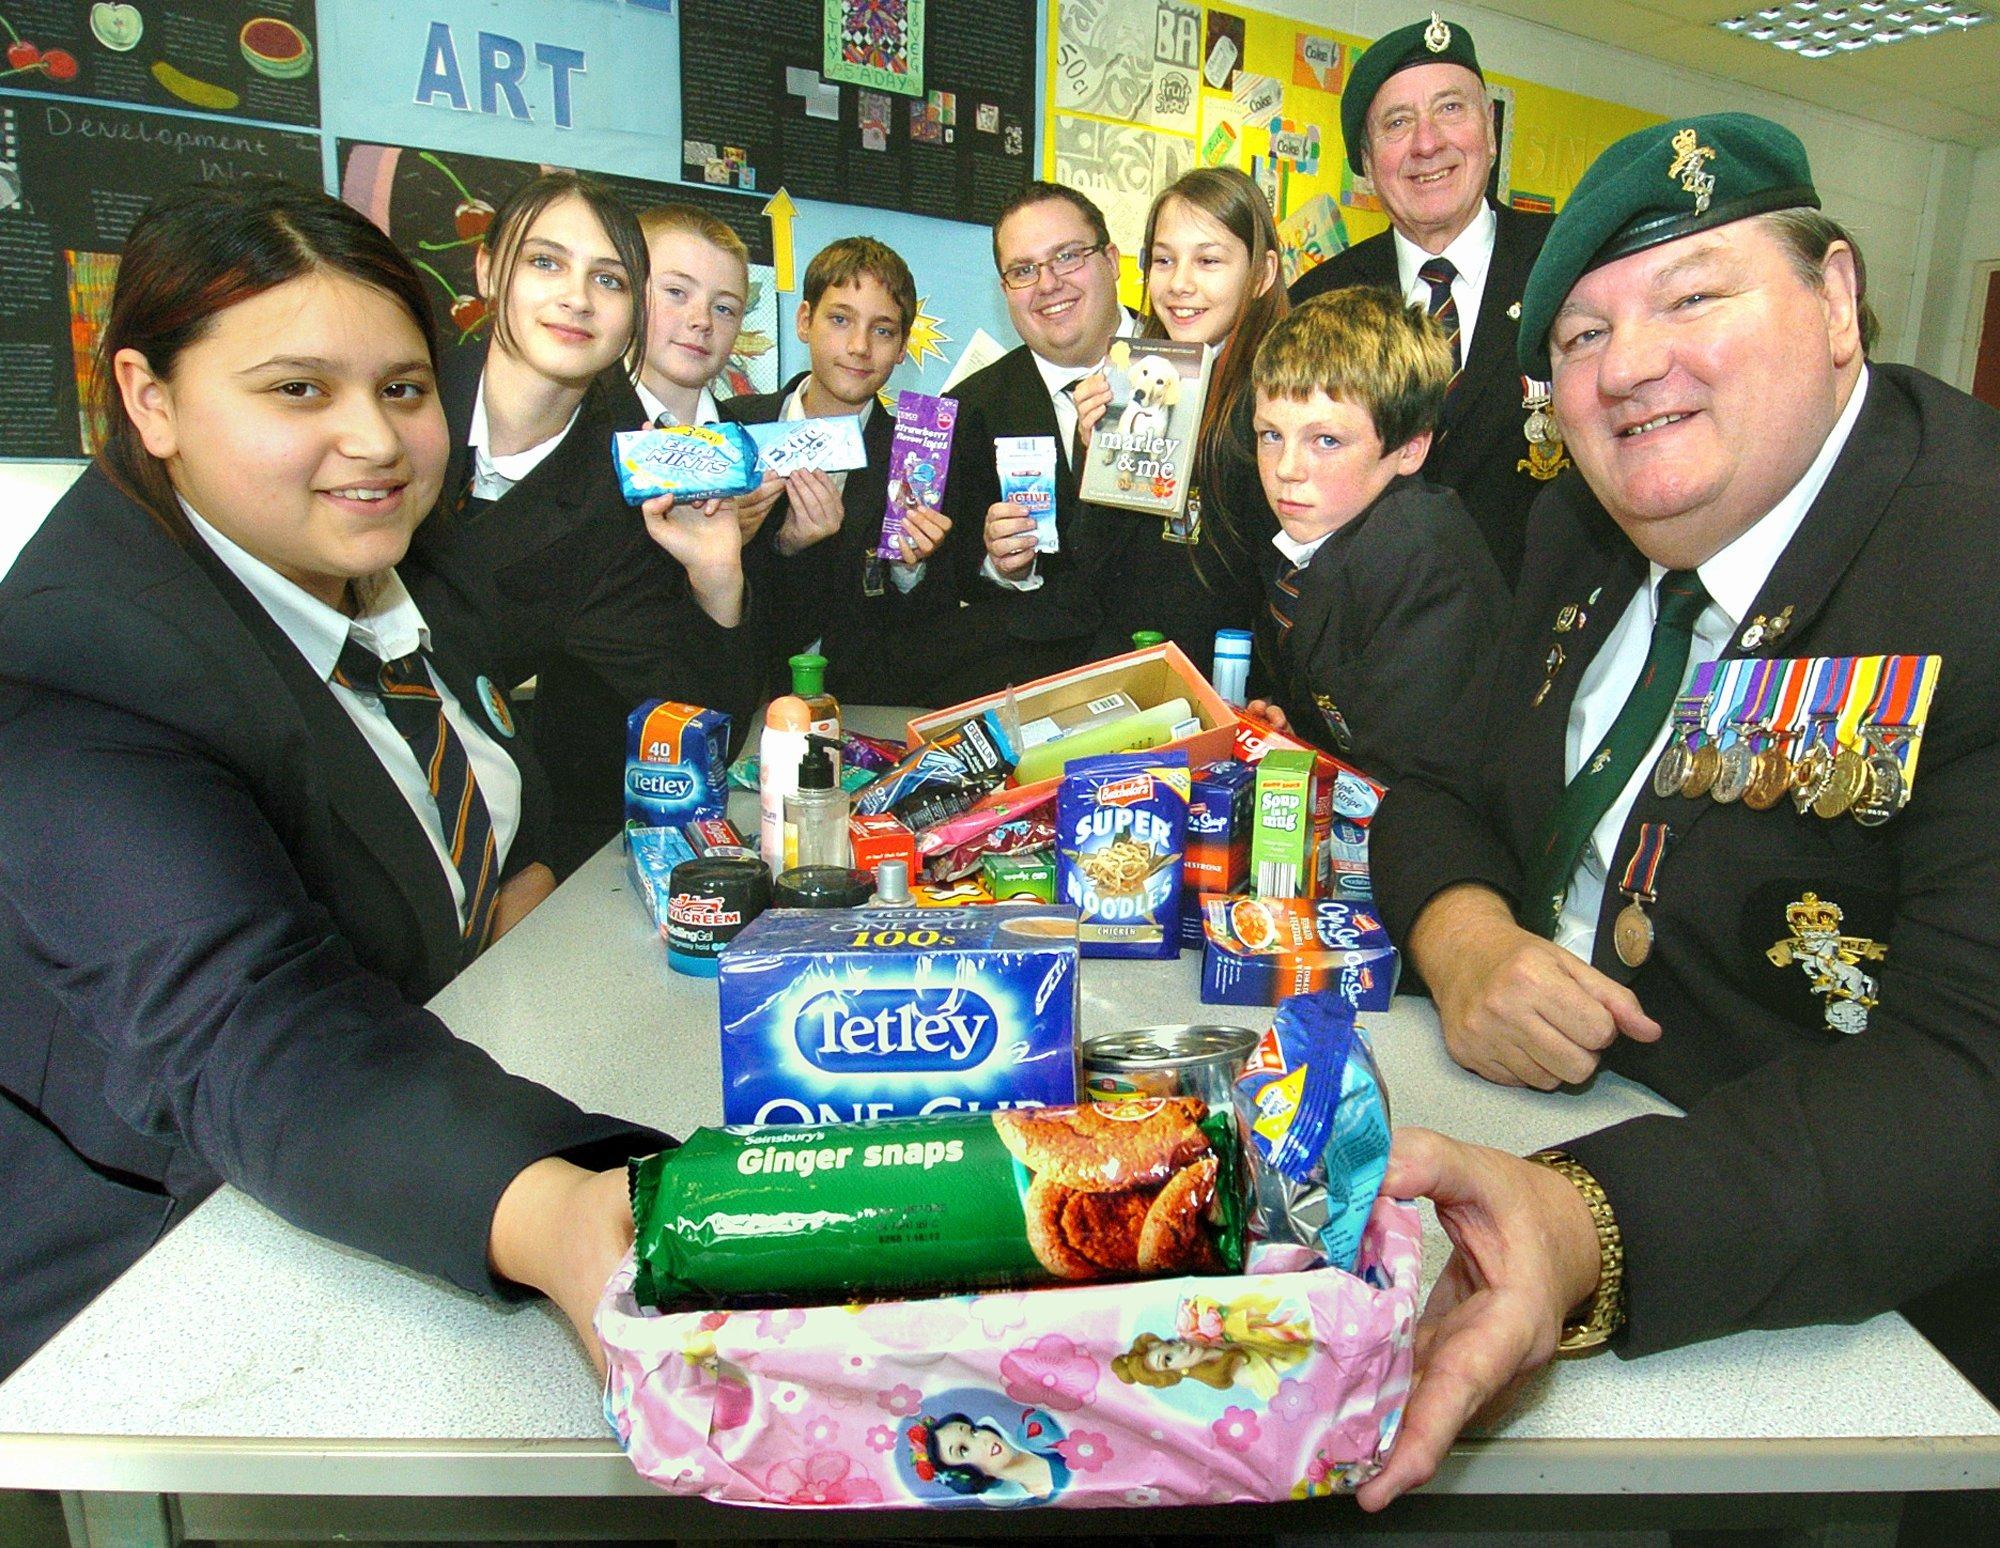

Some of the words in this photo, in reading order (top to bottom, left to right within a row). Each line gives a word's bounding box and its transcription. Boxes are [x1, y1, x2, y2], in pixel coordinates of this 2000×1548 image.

[1305, 45, 1328, 62] Coke
[413, 21, 587, 130] ART
[1249, 94, 1273, 113] Coke
[46, 106, 268, 156] Development
[1277, 139, 1300, 156] Coke
[1100, 427, 1180, 462] marley
[646, 449, 731, 475] MINTS
[648, 741, 671, 757] 40
[633, 772, 692, 797] Tetley
[1334, 781, 1355, 795] riple
[1261, 791, 1300, 812] Soup
[1074, 807, 1173, 850] SUPER
[1261, 812, 1299, 832] mug
[1066, 870, 1173, 921] NOODLES
[829, 922, 907, 932] ONE
[1096, 927, 1137, 937] CHICKEN
[850, 930, 957, 948] 100s
[815, 996, 990, 1061] Tetley
[743, 1131, 826, 1146] Sainsbury's
[736, 1146, 854, 1178] Ginger
[862, 1139, 965, 1171] snaps
